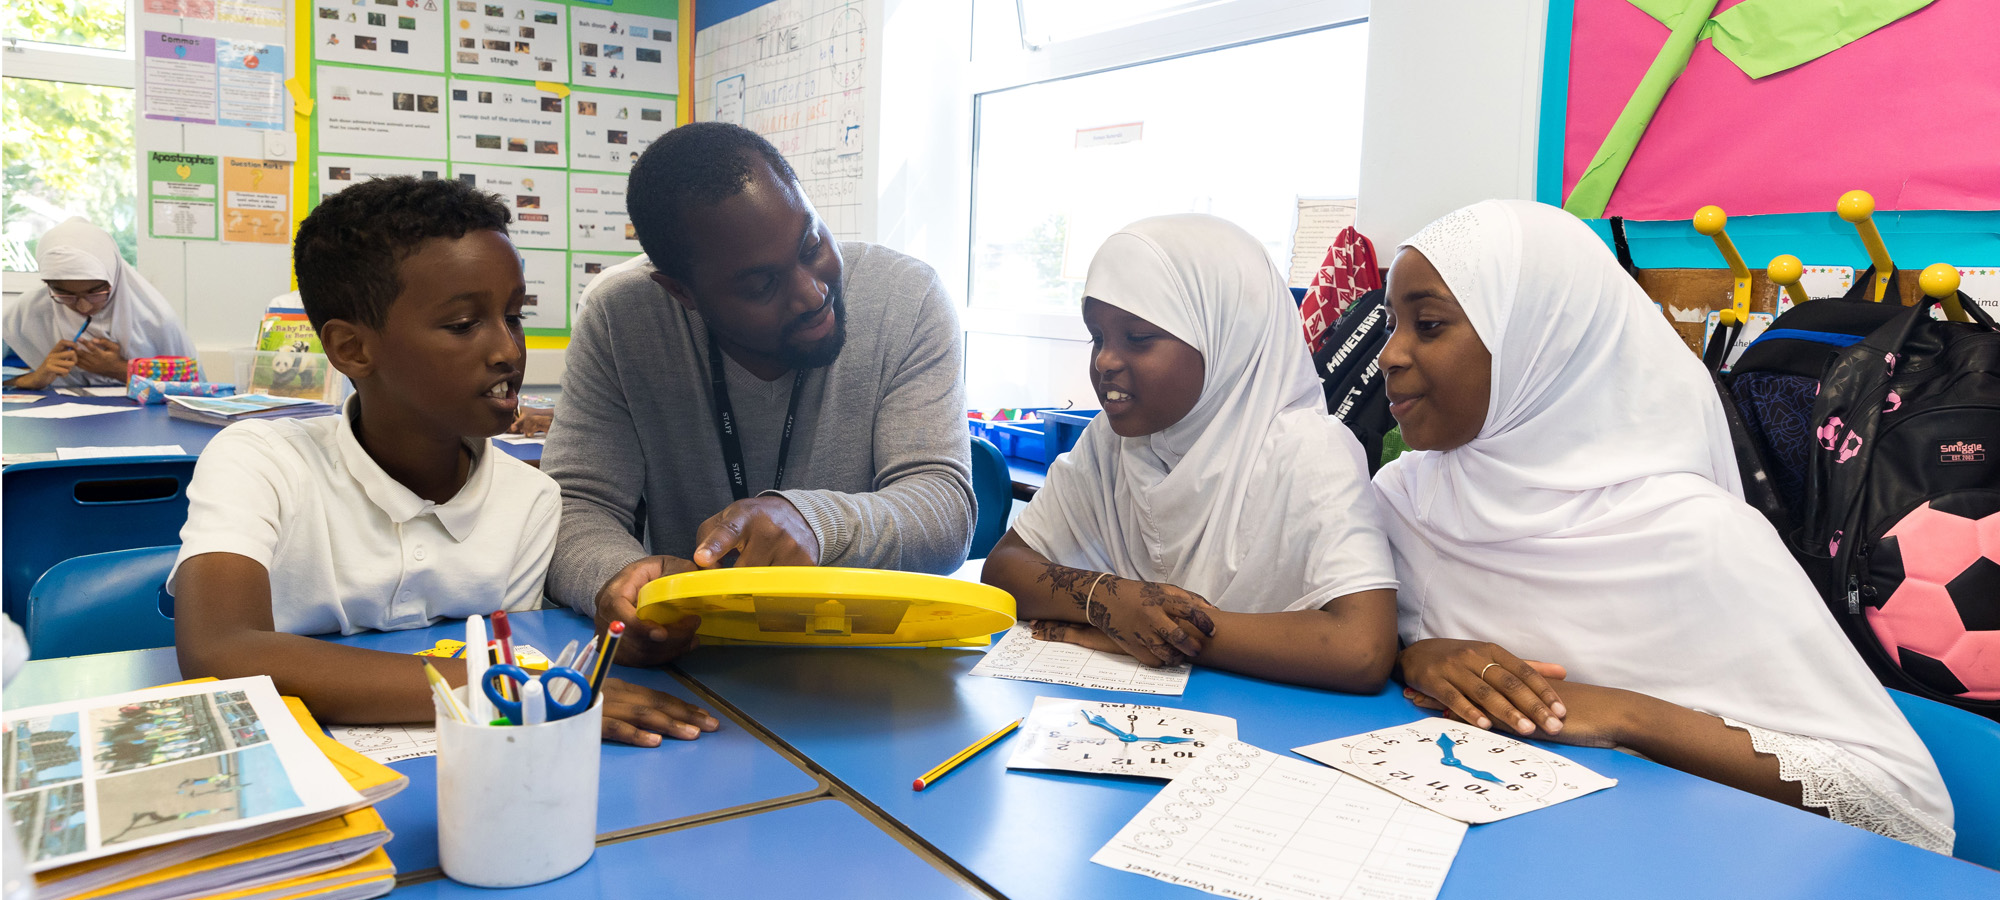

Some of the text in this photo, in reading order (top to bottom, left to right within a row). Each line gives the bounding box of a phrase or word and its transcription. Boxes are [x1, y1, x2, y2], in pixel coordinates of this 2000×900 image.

[161, 34, 200, 46] Commas
[756, 26, 800, 60] TIME
[490, 56, 519, 67] strange
[754, 82, 801, 108] Quarter
[153, 151, 215, 167] Apostrophes
[231, 160, 284, 170] Question Marks
[275, 325, 298, 333] Baby
[1326, 303, 1385, 374] MINECRAFT
[722, 411, 732, 435] STAFF
[785, 414, 794, 438] STAFF
[732, 463, 742, 486] STAFF
[992, 673, 1053, 683] Worksheet
[1090, 683, 1156, 693] Converting
[1132, 704, 1161, 712] half
[1126, 714, 1138, 722] 6
[1157, 719, 1169, 727] 7
[1182, 727, 1194, 735] 8
[1056, 743, 1069, 751] 2
[1193, 740, 1205, 749] 9
[385, 749, 437, 761] ksheet
[1173, 751, 1196, 759] 10
[1111, 757, 1135, 766] 12
[1150, 757, 1169, 765] 11
[1509, 758, 1527, 766] 7
[1389, 770, 1415, 781] 12
[1520, 771, 1537, 779] 8
[1426, 780, 1450, 791] 11
[1463, 783, 1490, 796] 10
[1506, 783, 1524, 791] 9
[1121, 844, 1161, 859] Analogue
[1186, 862, 1211, 872] Clock
[1125, 863, 1215, 892] Worksheet
[1214, 869, 1234, 878] Hour
[1265, 881, 1290, 892] Clock
